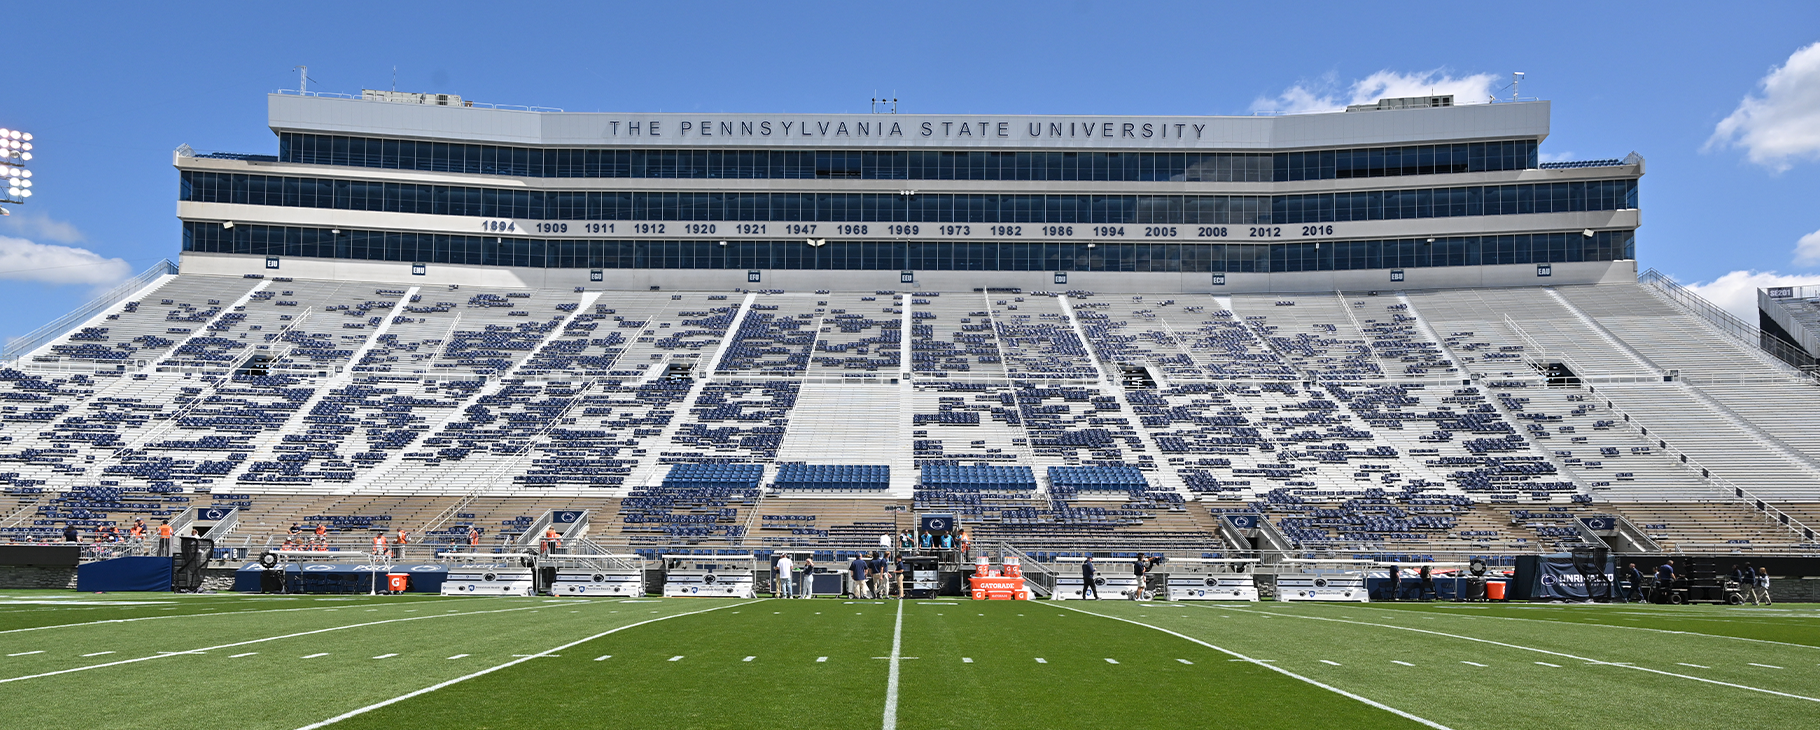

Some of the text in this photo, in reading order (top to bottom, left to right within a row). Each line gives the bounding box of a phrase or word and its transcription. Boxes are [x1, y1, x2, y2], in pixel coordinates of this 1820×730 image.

[609, 121, 1206, 138] THE PENNSYLVANIA STATE UNIVERSITY
[482, 220, 1333, 237] 1894 1909 1911 1912 1920 1921 1947 1968 1969 1973 1982 1986 1994 2005 2008 2012 2016
[1213, 276, 1225, 284] ECU
[392, 577, 399, 586] G
